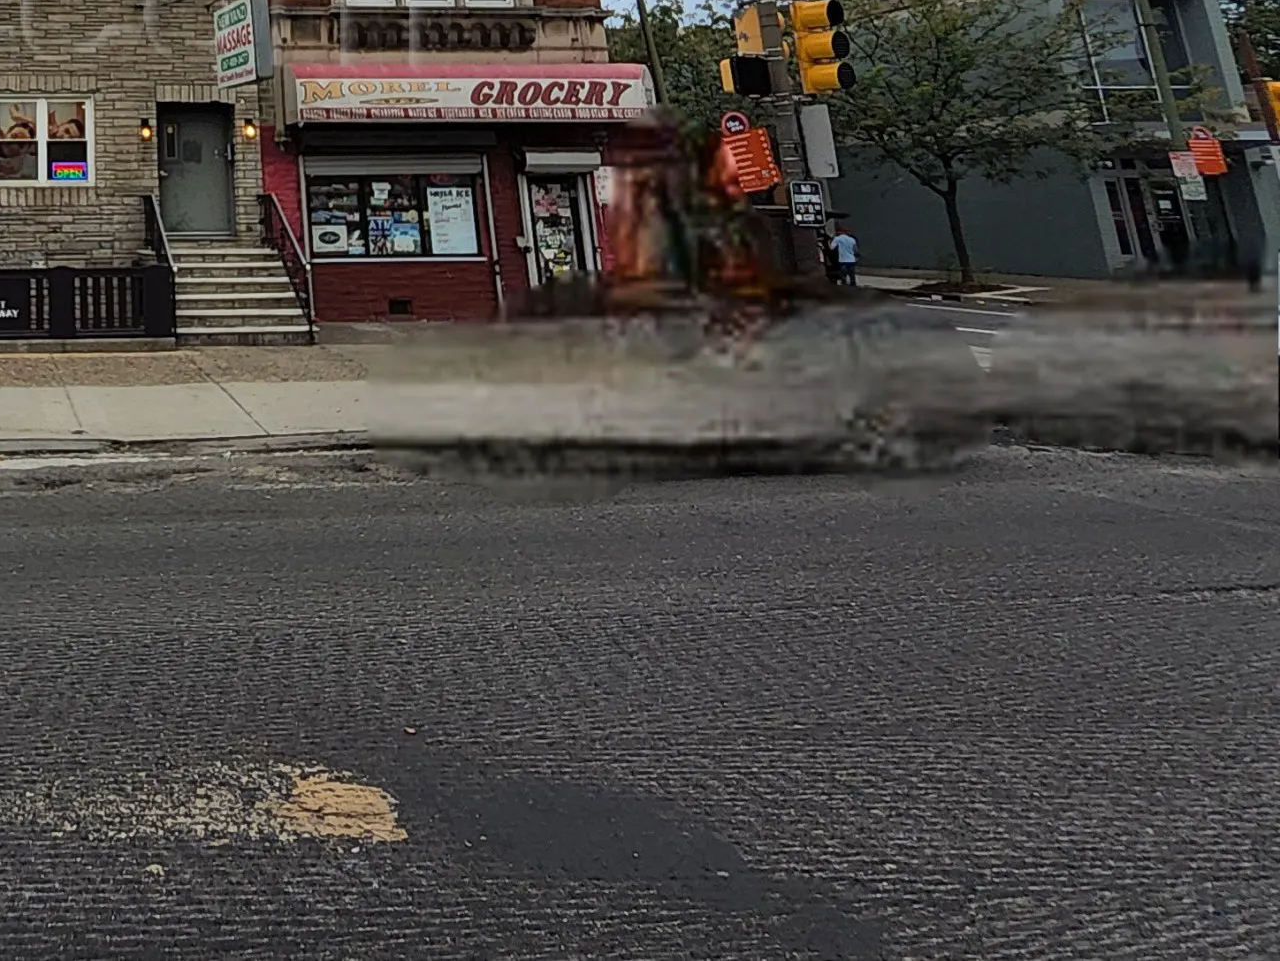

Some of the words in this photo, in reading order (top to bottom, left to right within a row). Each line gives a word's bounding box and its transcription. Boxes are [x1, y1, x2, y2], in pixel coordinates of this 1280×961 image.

[216, 23, 252, 54] MASSAGE
[300, 80, 461, 105] MOREL
[469, 80, 632, 106] GROCERY
[56, 169, 83, 178] OPEN
